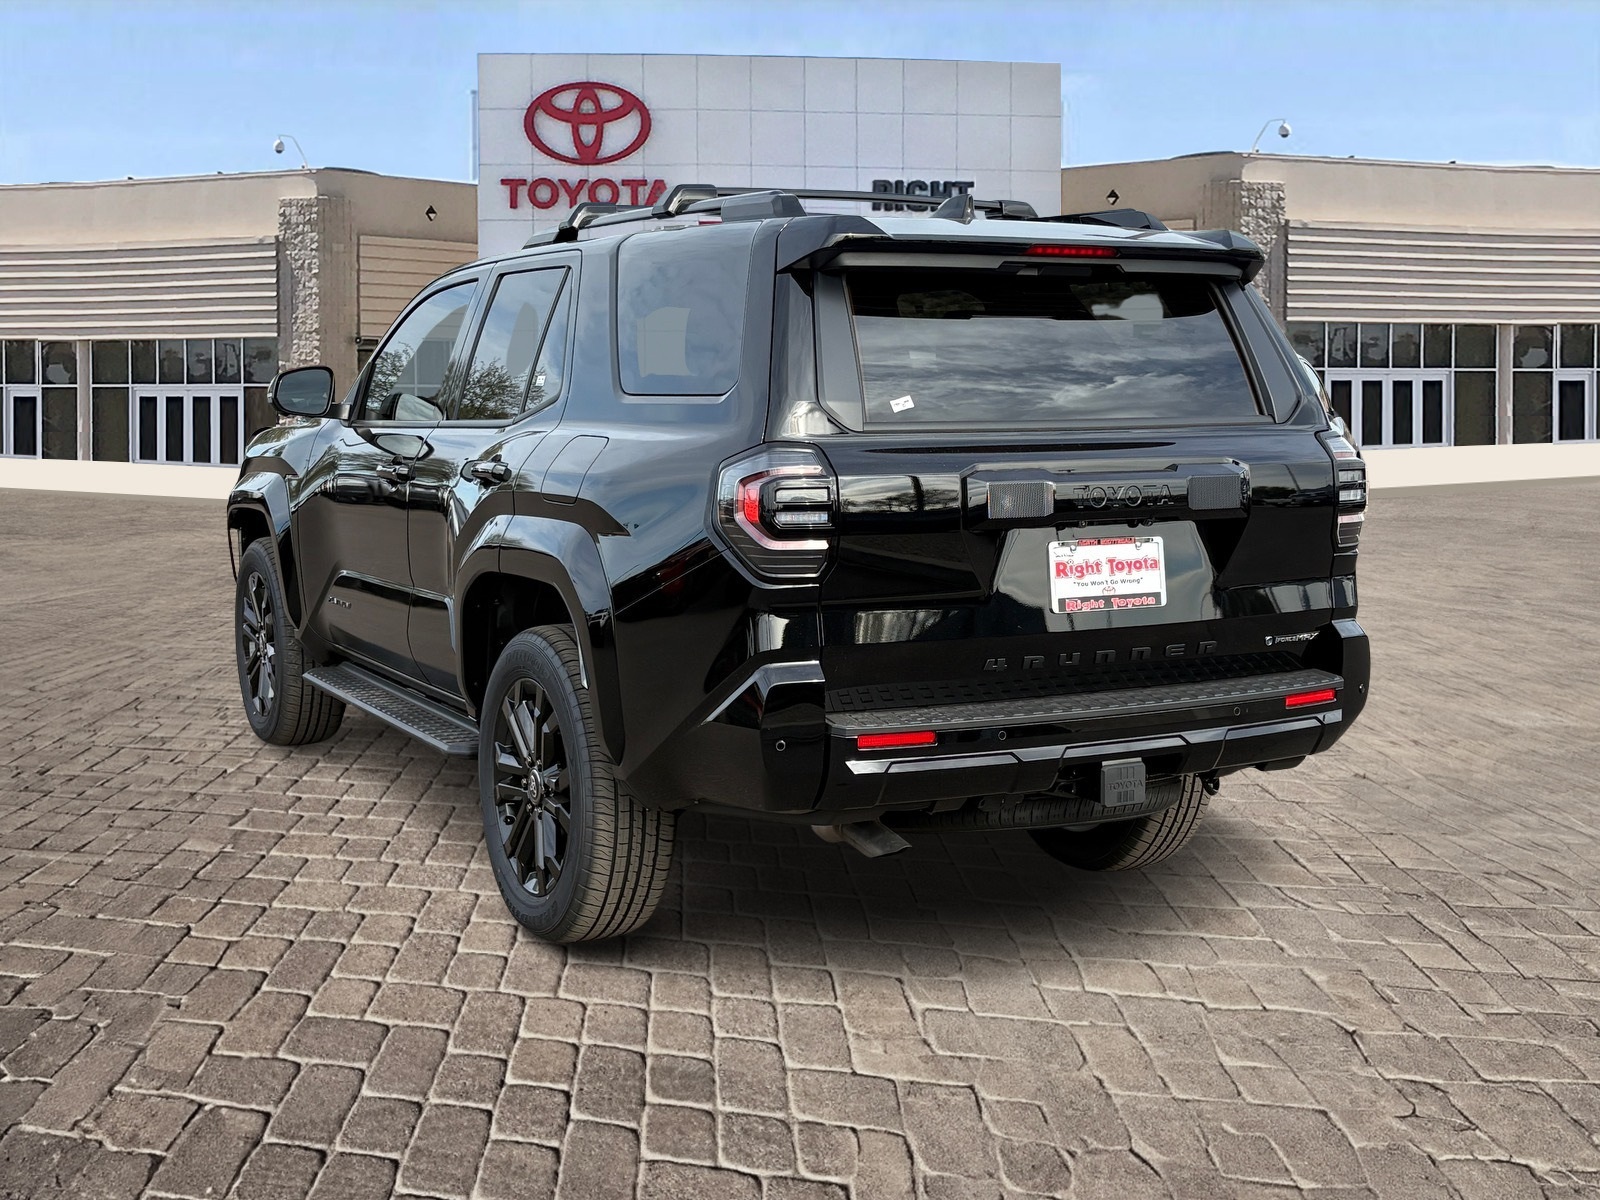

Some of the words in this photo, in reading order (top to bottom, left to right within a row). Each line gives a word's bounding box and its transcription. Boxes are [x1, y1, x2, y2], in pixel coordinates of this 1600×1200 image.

[500, 178, 668, 210] TOYOTA
[1073, 485, 1174, 509] TOYOTA
[1055, 560, 1101, 579] Right
[1106, 557, 1158, 576] Toyota
[1065, 599, 1105, 612] Right
[1111, 596, 1156, 608] Toyota
[983, 640, 1218, 671] 4RUNNER
[1107, 780, 1144, 791] TOYOTA
